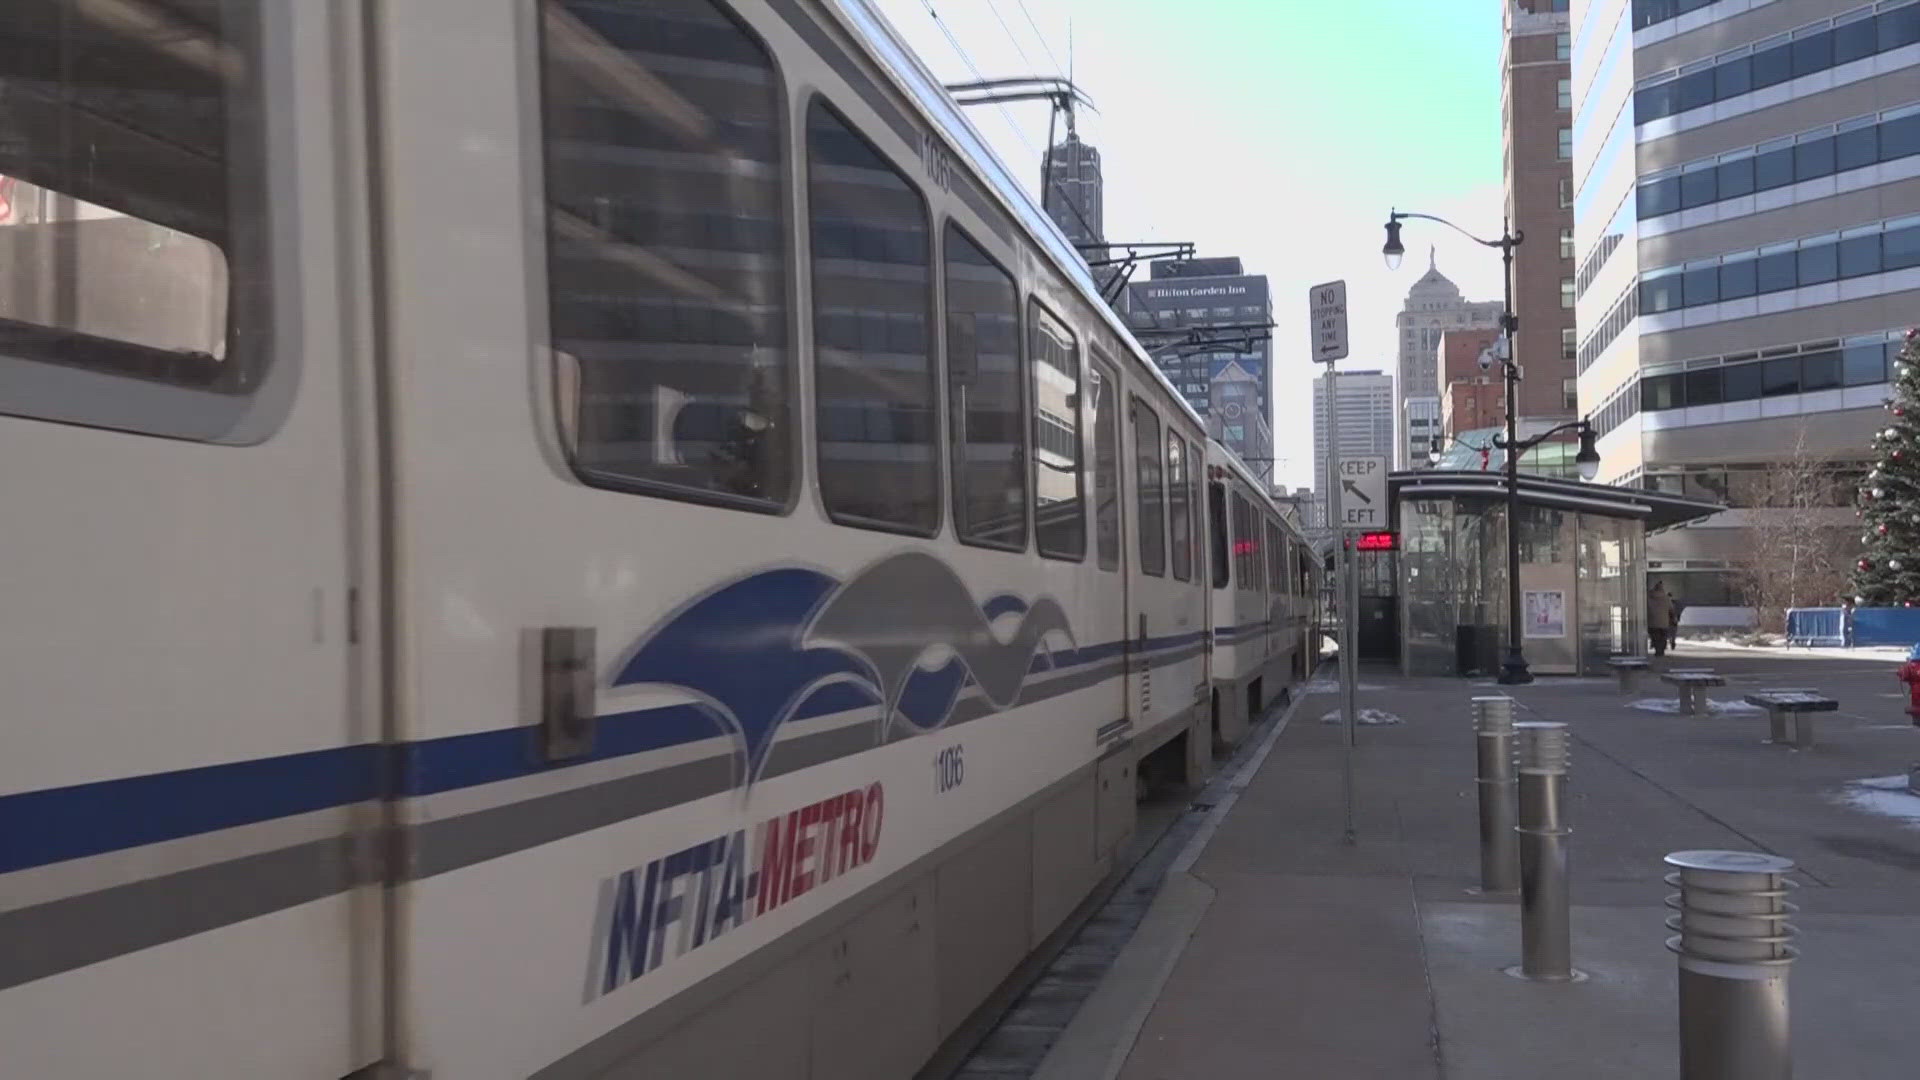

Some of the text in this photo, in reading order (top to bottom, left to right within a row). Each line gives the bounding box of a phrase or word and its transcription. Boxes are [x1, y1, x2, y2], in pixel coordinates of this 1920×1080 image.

[920, 134, 950, 195] 106
[1157, 285, 1246, 297] Hilton Garden Inn
[1320, 289, 1335, 305] NO
[1322, 318, 1336, 329] ANY
[1321, 330, 1336, 342] TIME
[937, 743, 964, 794] 106
[583, 780, 884, 1005] NFTA-METRO
